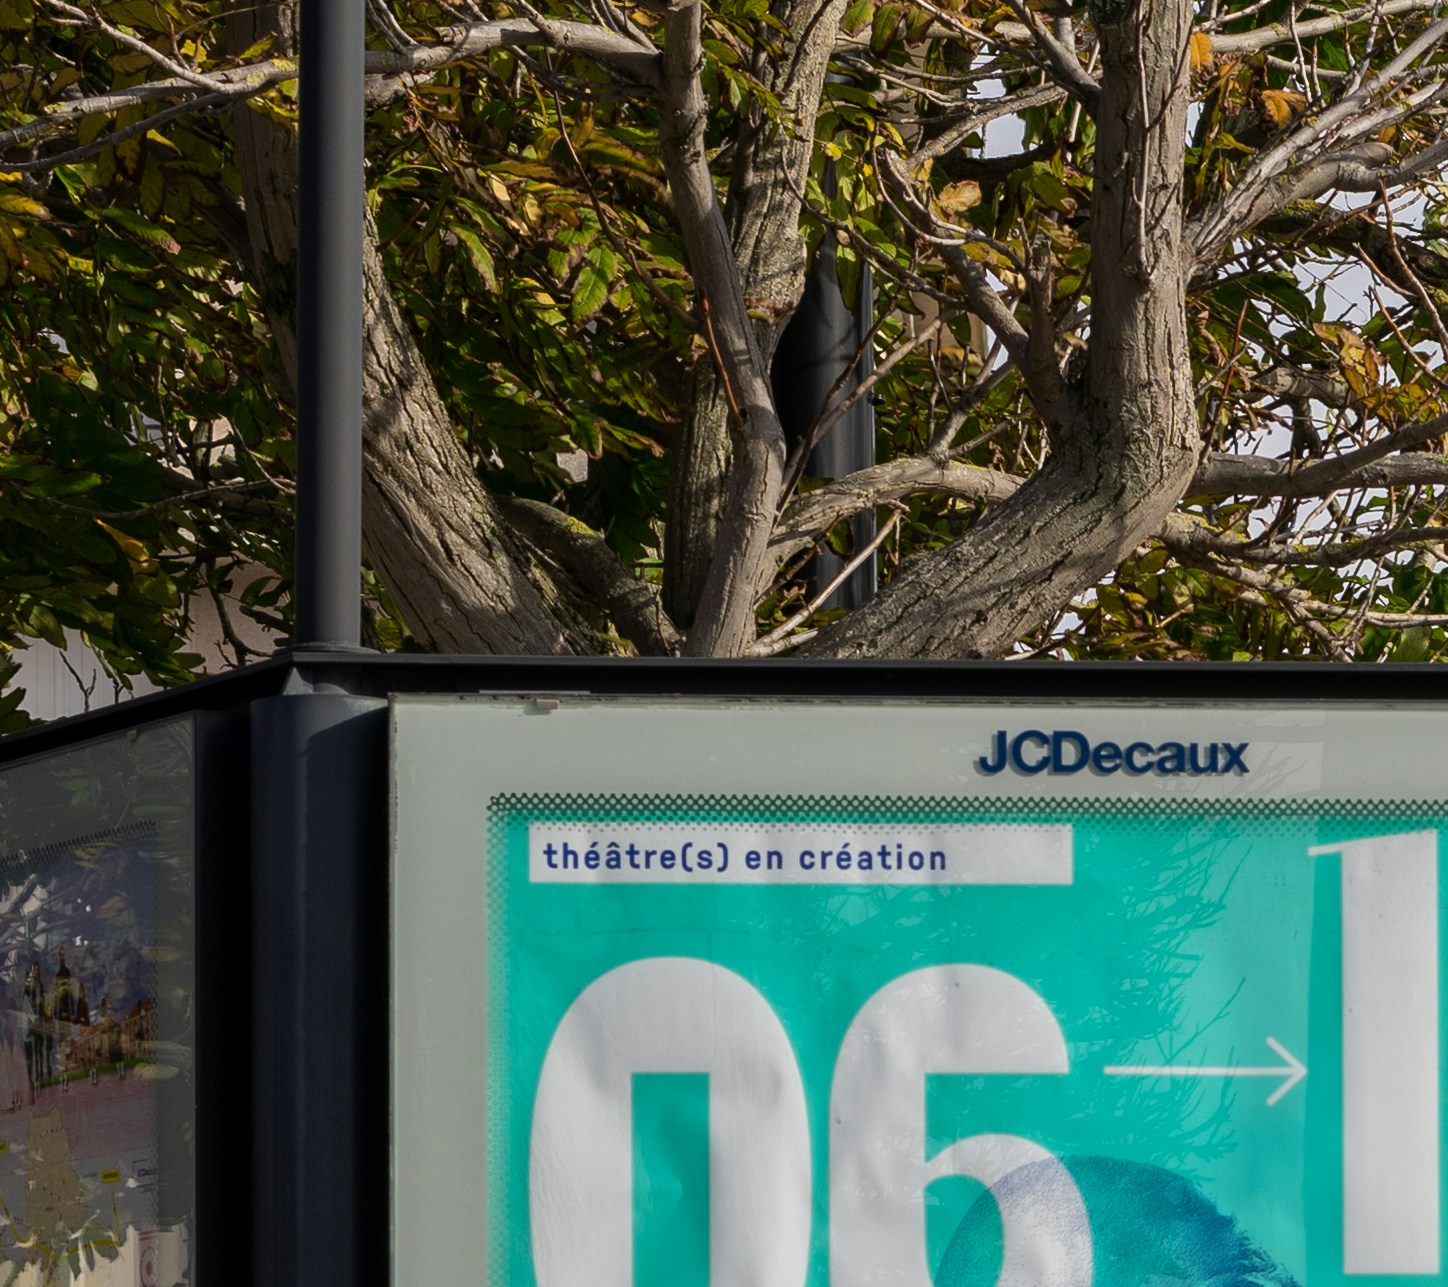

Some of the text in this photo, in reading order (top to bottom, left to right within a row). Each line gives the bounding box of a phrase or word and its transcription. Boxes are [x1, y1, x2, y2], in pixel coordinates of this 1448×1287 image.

[977, 730, 1250, 774] JCDecaux
[542, 842, 948, 873] théâtre(s) en création
